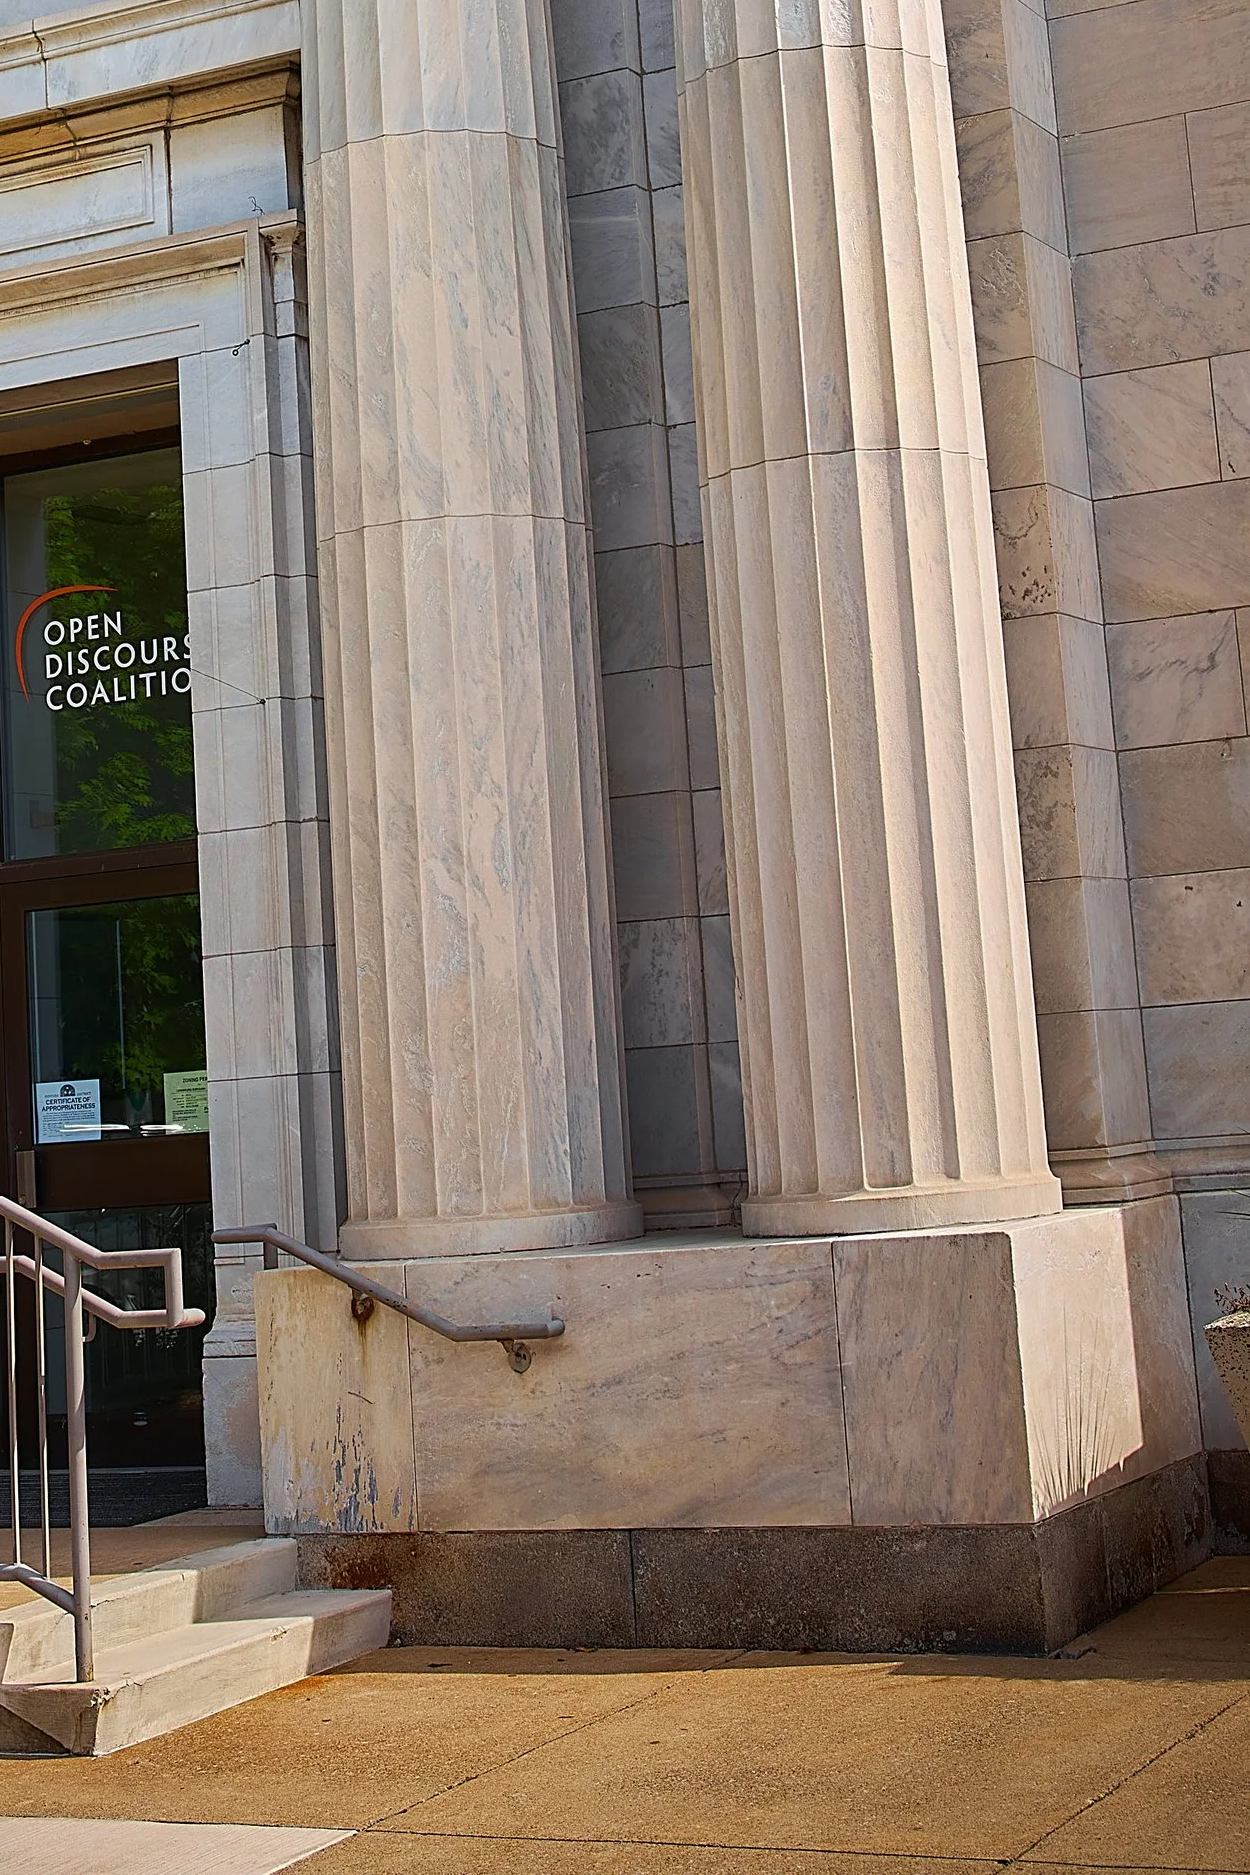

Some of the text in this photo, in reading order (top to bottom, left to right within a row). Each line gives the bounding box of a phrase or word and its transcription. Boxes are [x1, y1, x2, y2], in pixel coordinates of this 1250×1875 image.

[43, 610, 123, 646] OPEN
[45, 633, 191, 679] DISCOURS
[46, 667, 191, 711] COALITIO
[41, 1102, 96, 1112] APPROPRIATENESS
[45, 1097, 82, 1105] CERTIFICATE
